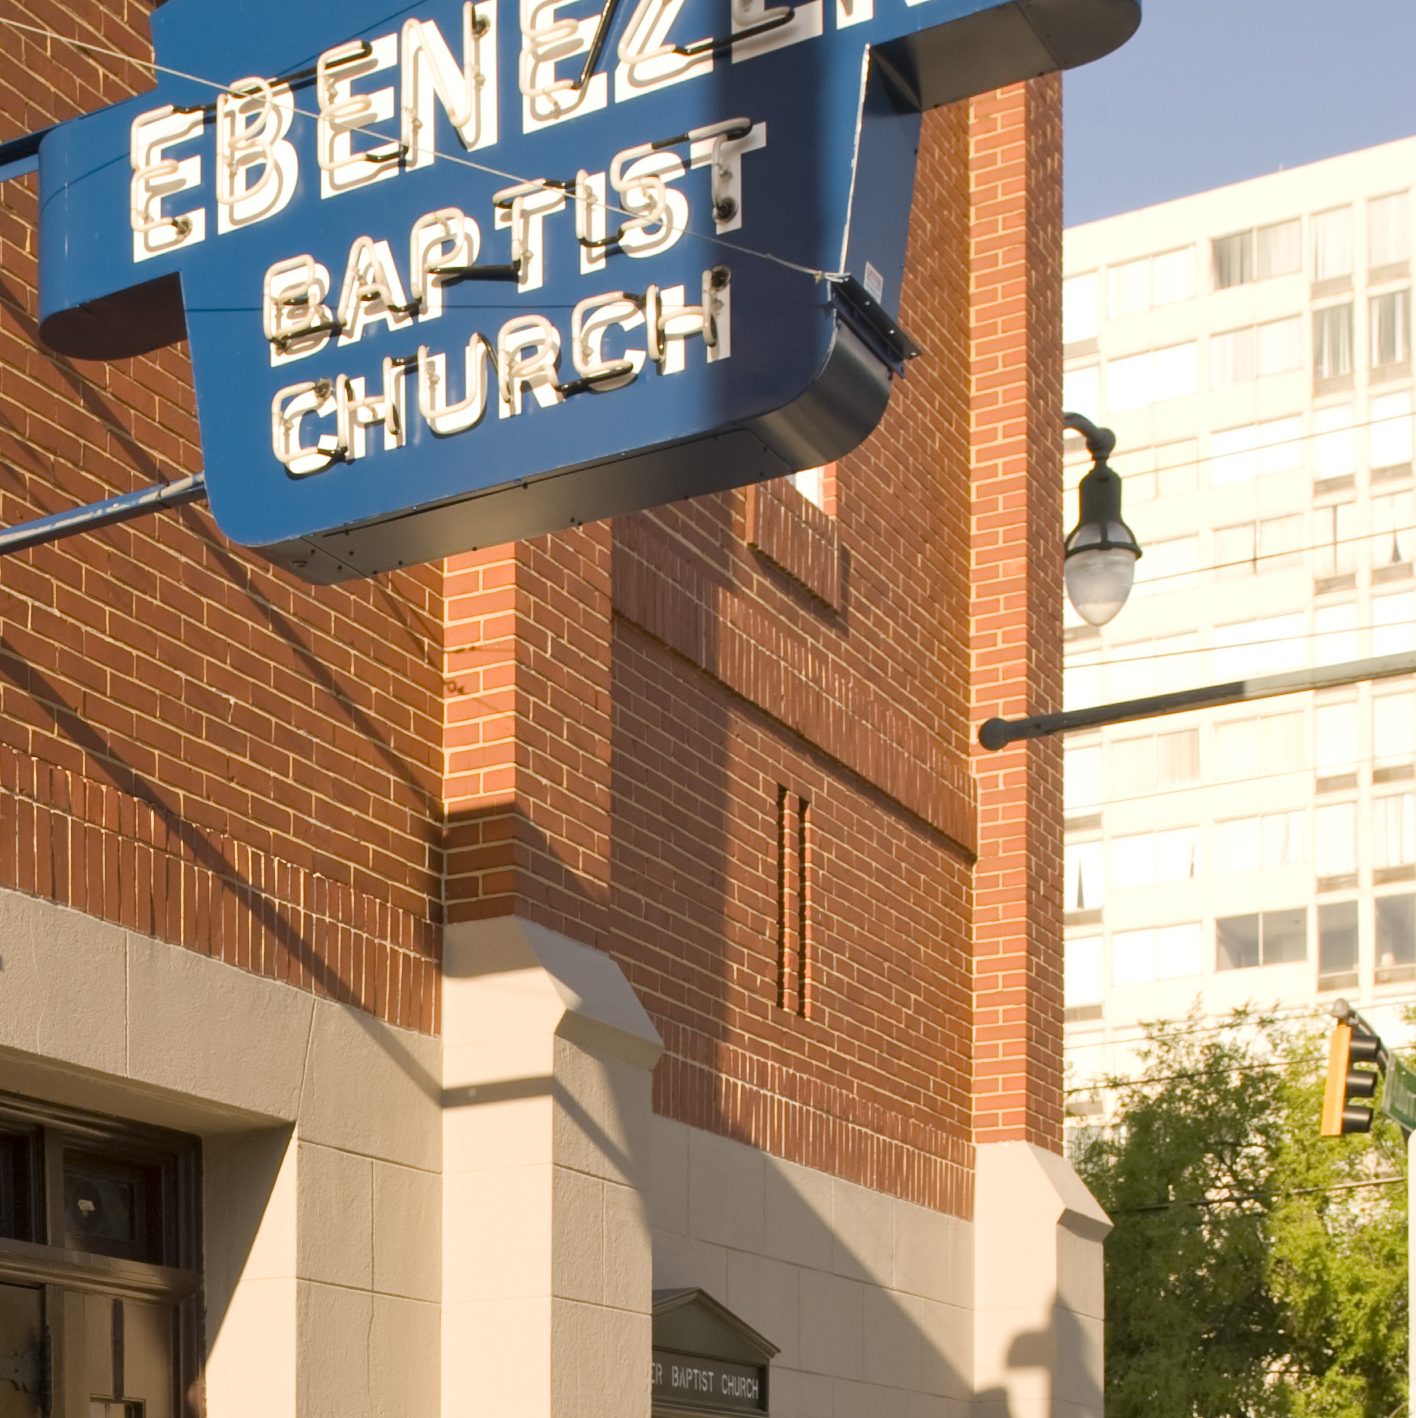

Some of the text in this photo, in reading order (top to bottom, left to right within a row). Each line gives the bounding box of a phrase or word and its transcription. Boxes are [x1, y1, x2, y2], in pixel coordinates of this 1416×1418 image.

[264, 118, 766, 366] BAPTIST
[272, 264, 732, 475] CHURCH
[671, 1365, 714, 1392] BAPTIST
[721, 1374, 759, 1399] CHURCH
